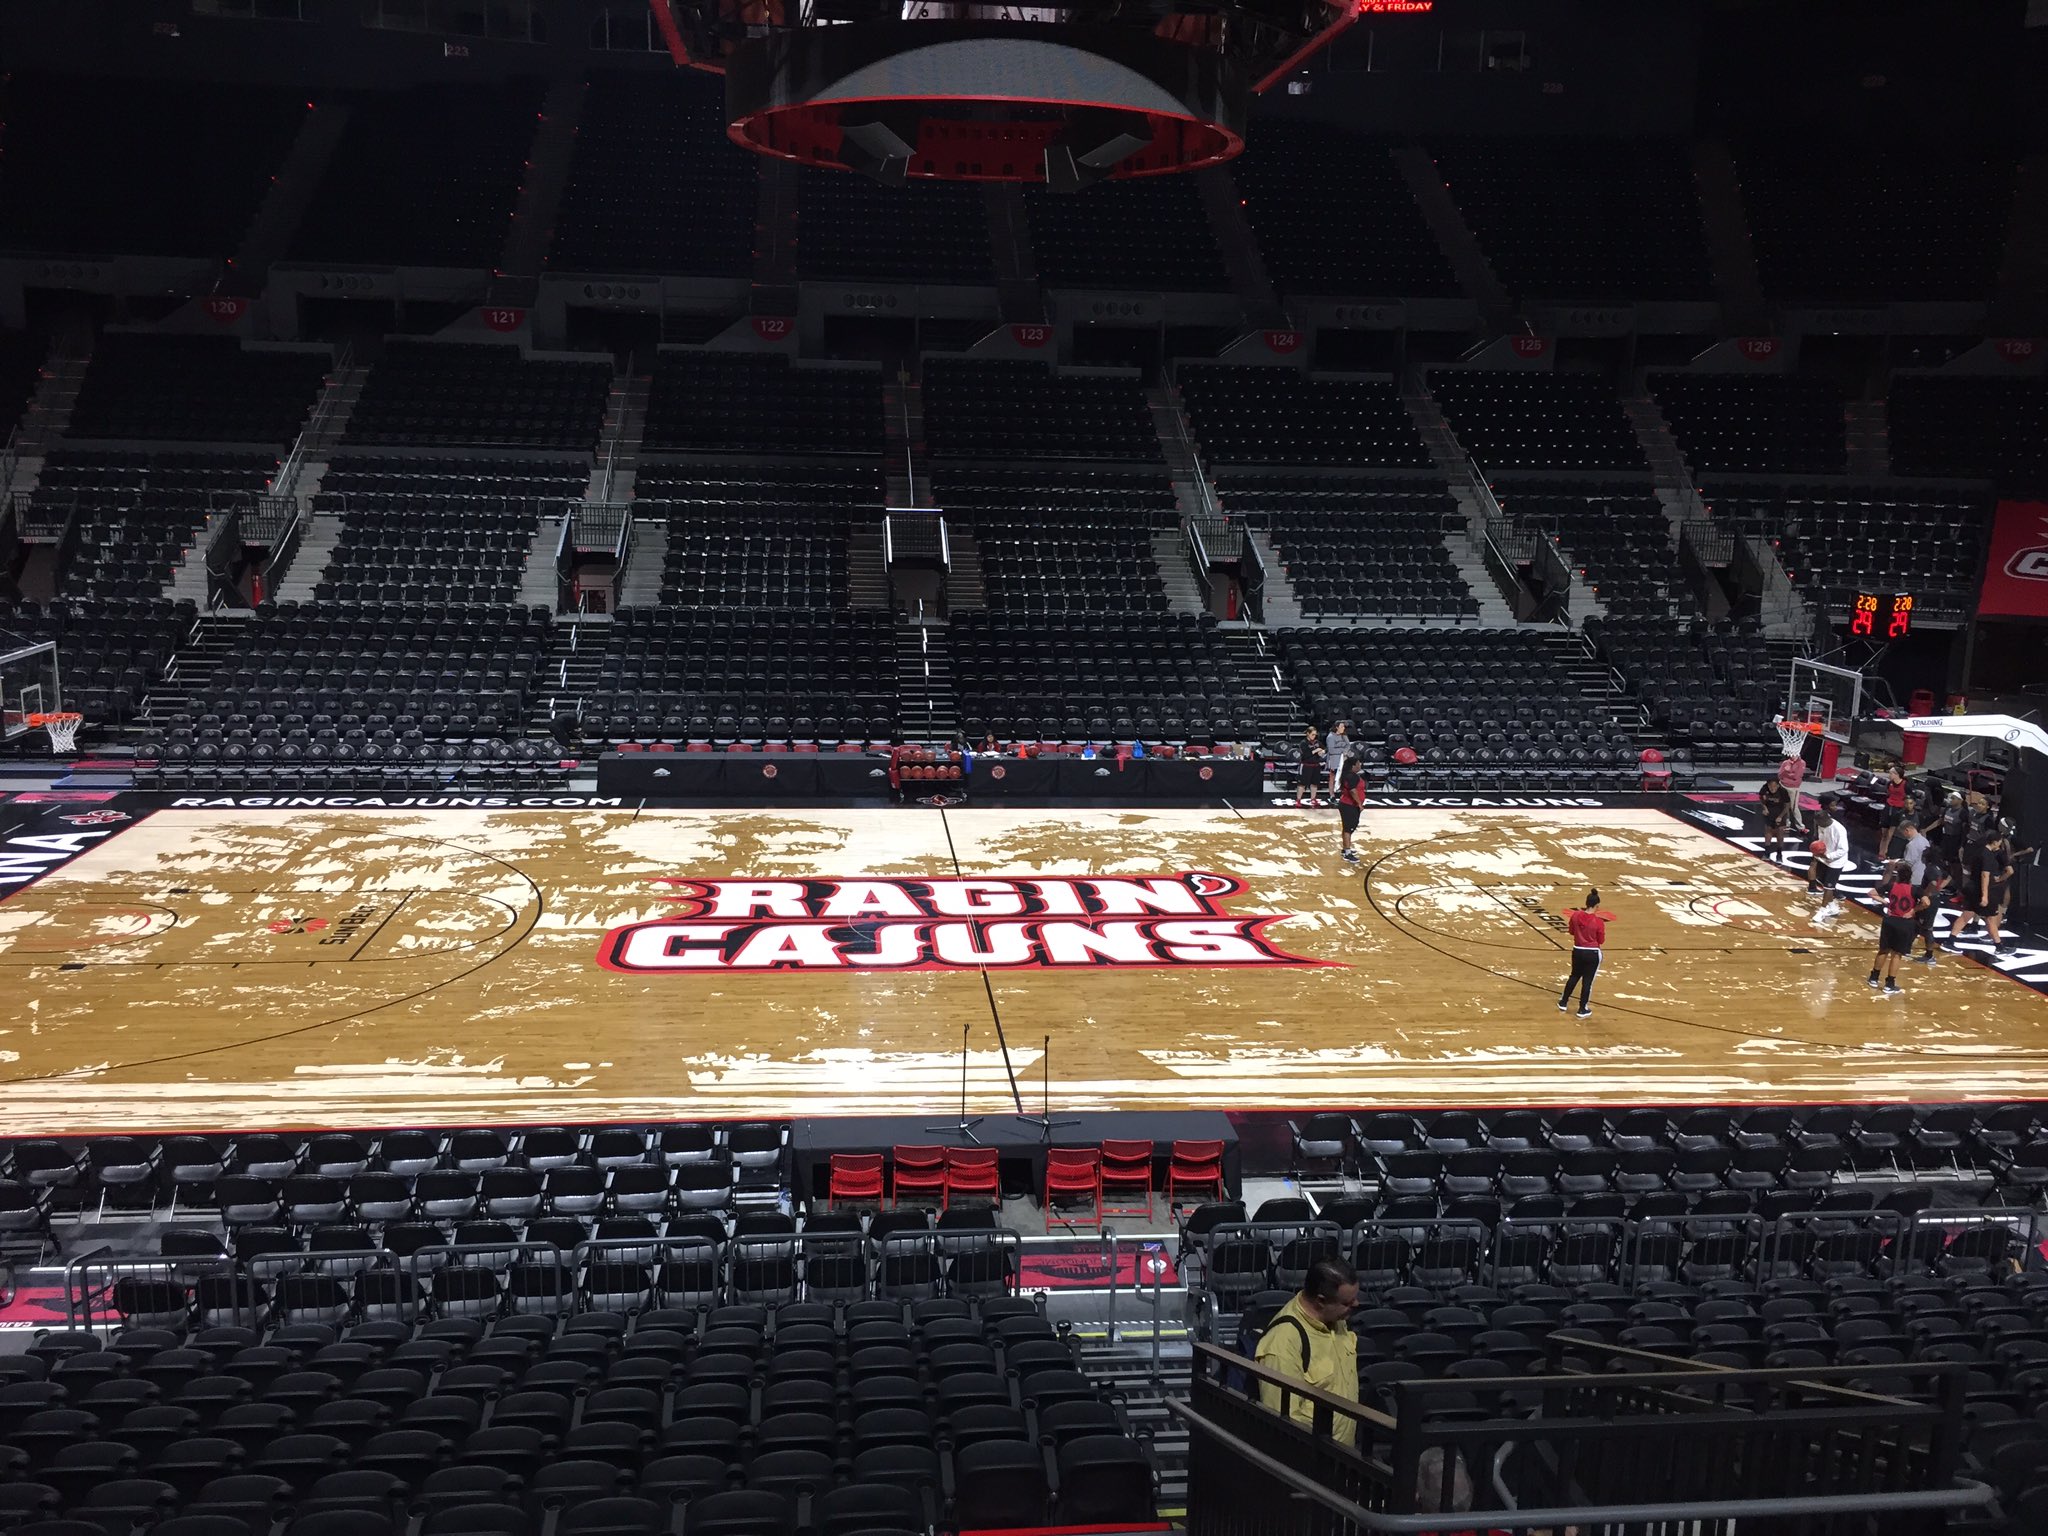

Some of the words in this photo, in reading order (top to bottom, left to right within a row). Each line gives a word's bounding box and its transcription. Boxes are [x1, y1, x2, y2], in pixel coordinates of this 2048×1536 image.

[1387, 2, 1433, 11] FRIDAY
[210, 301, 238, 314] 120
[491, 311, 515, 324] 121
[760, 320, 785, 333] 122
[1020, 328, 1044, 341] 123
[1271, 334, 1295, 346] 124
[1746, 340, 1772, 353] 126
[1857, 595, 1877, 611] 2:28
[1894, 596, 1912, 611] 2:28
[1911, 718, 1944, 727] SPALDING
[171, 797, 623, 807] RAGINCAJUNS.COM
[1271, 797, 1604, 808] #GAUXCAJUNS
[699, 880, 1206, 918] RAGIN
[624, 921, 1276, 968] CAJUNS
